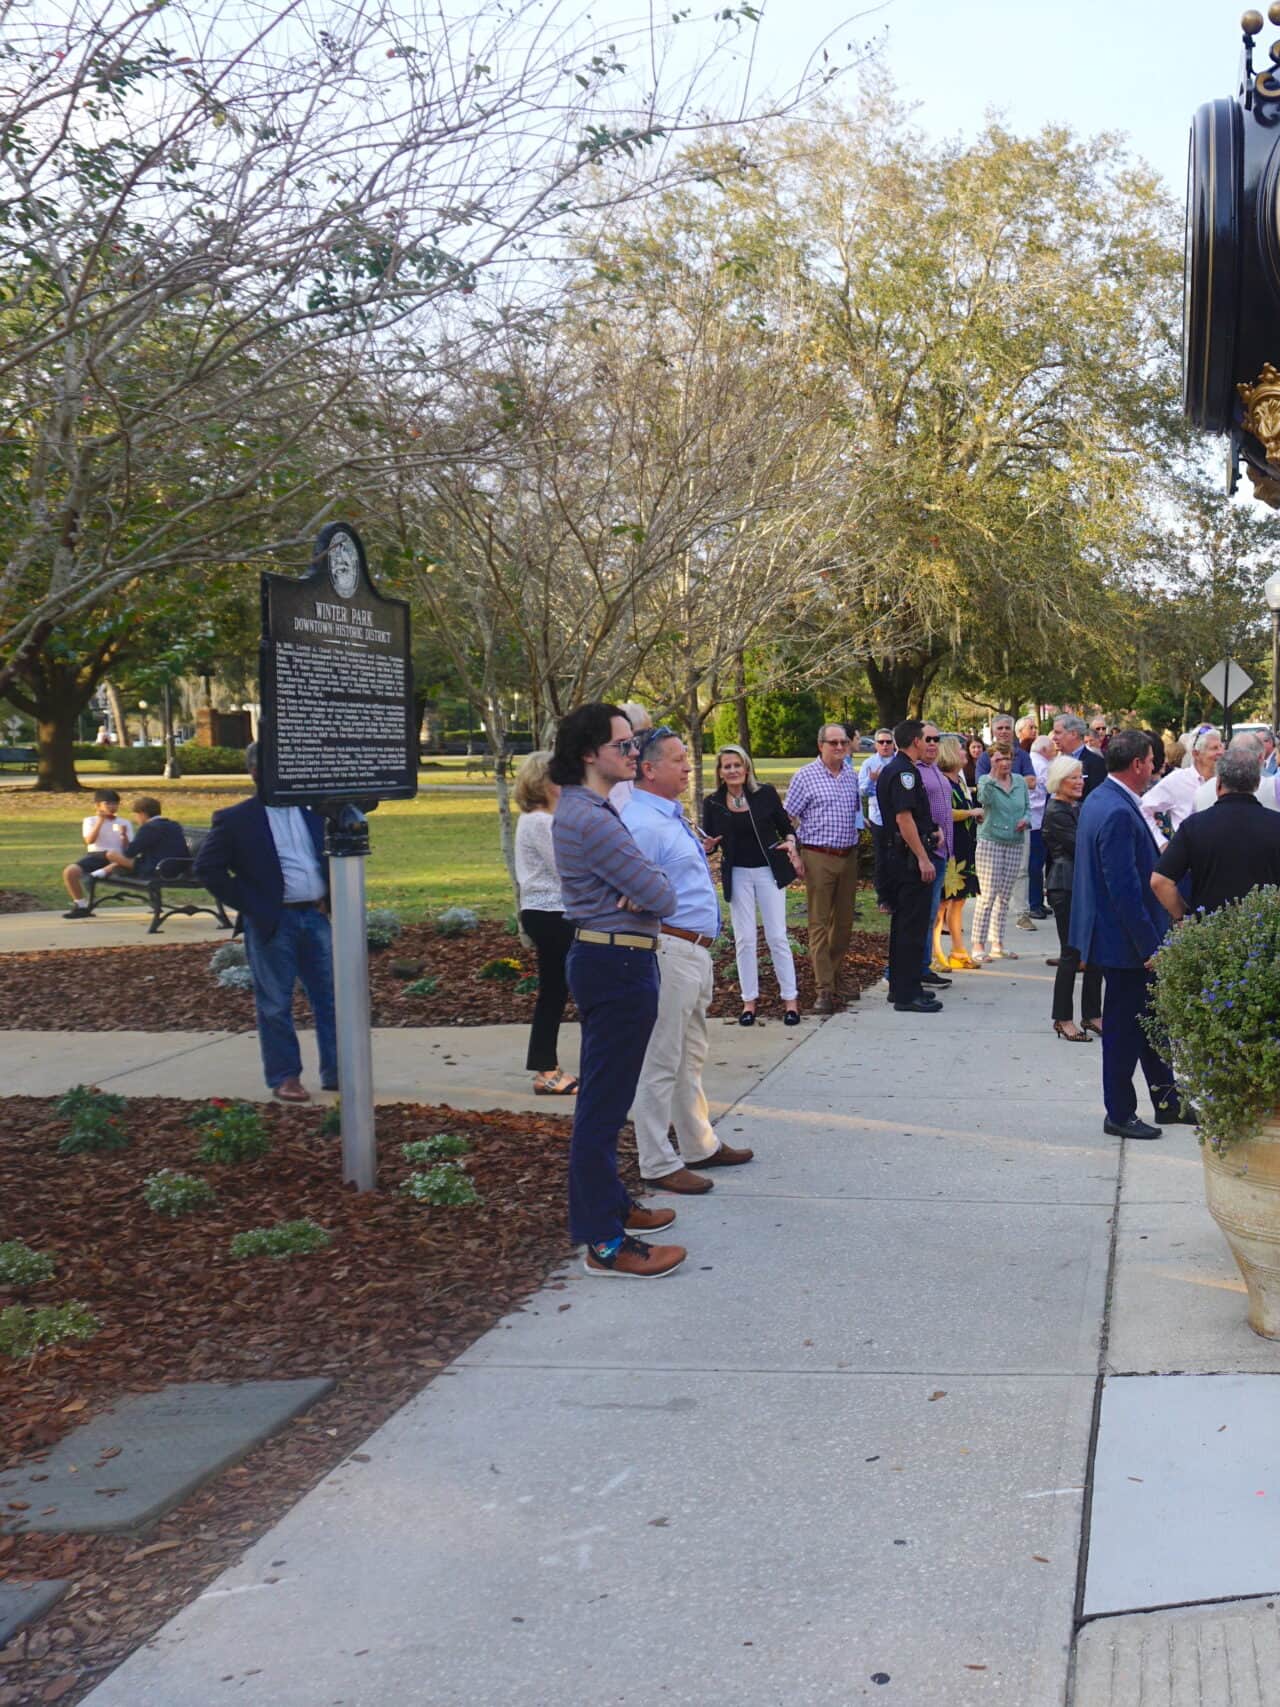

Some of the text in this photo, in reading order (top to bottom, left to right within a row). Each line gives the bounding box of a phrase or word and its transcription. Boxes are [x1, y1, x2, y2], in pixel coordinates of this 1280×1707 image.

[315, 602, 374, 627] WINTER PARK
[294, 617, 391, 644] DOWNTOWN HISTORIC DISTRICT
